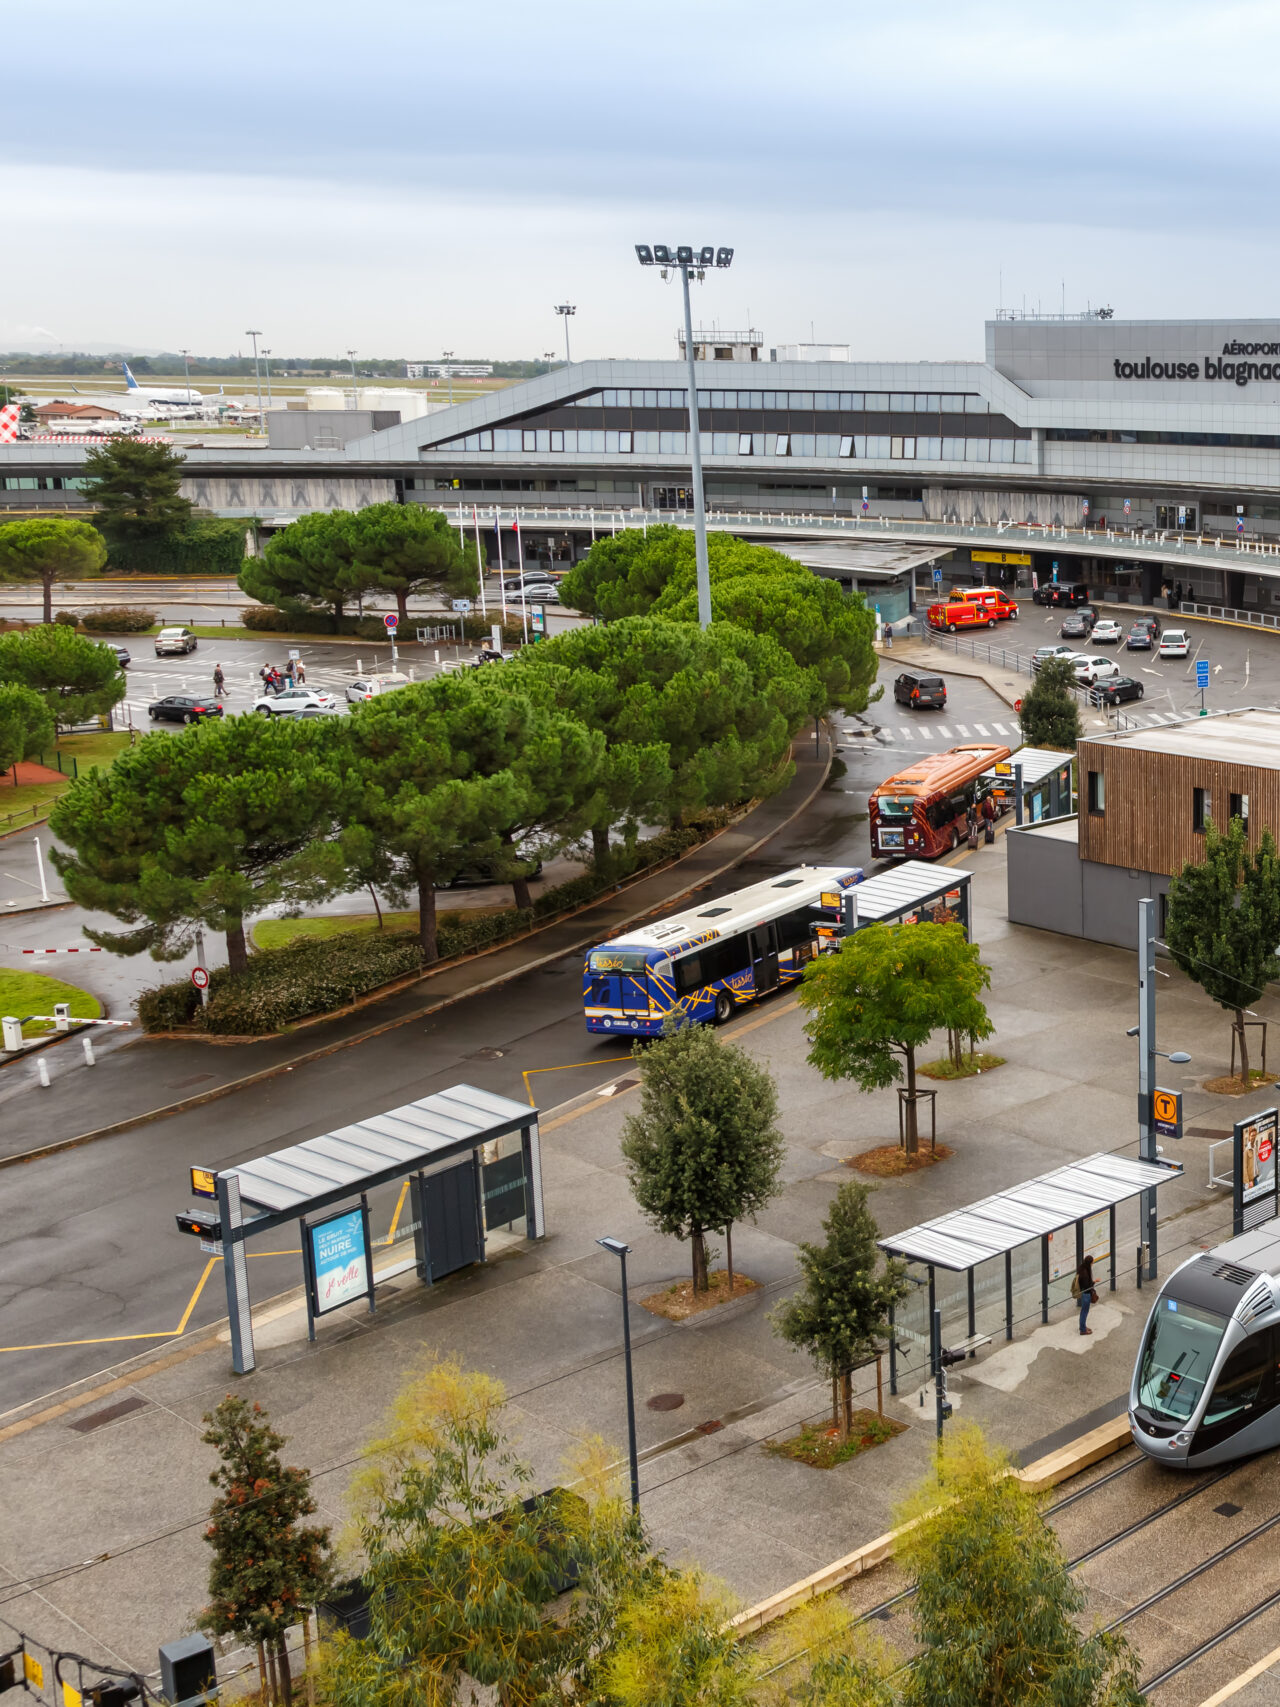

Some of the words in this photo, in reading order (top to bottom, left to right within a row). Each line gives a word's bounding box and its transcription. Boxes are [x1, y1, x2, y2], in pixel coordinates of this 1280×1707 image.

[1113, 356, 1200, 380] toulouse
[1001, 553, 1007, 562] B
[1160, 1098, 1171, 1115] T
[320, 1239, 352, 1259] NUIRE
[325, 1277, 336, 1299] je
[337, 1265, 359, 1287] veille
